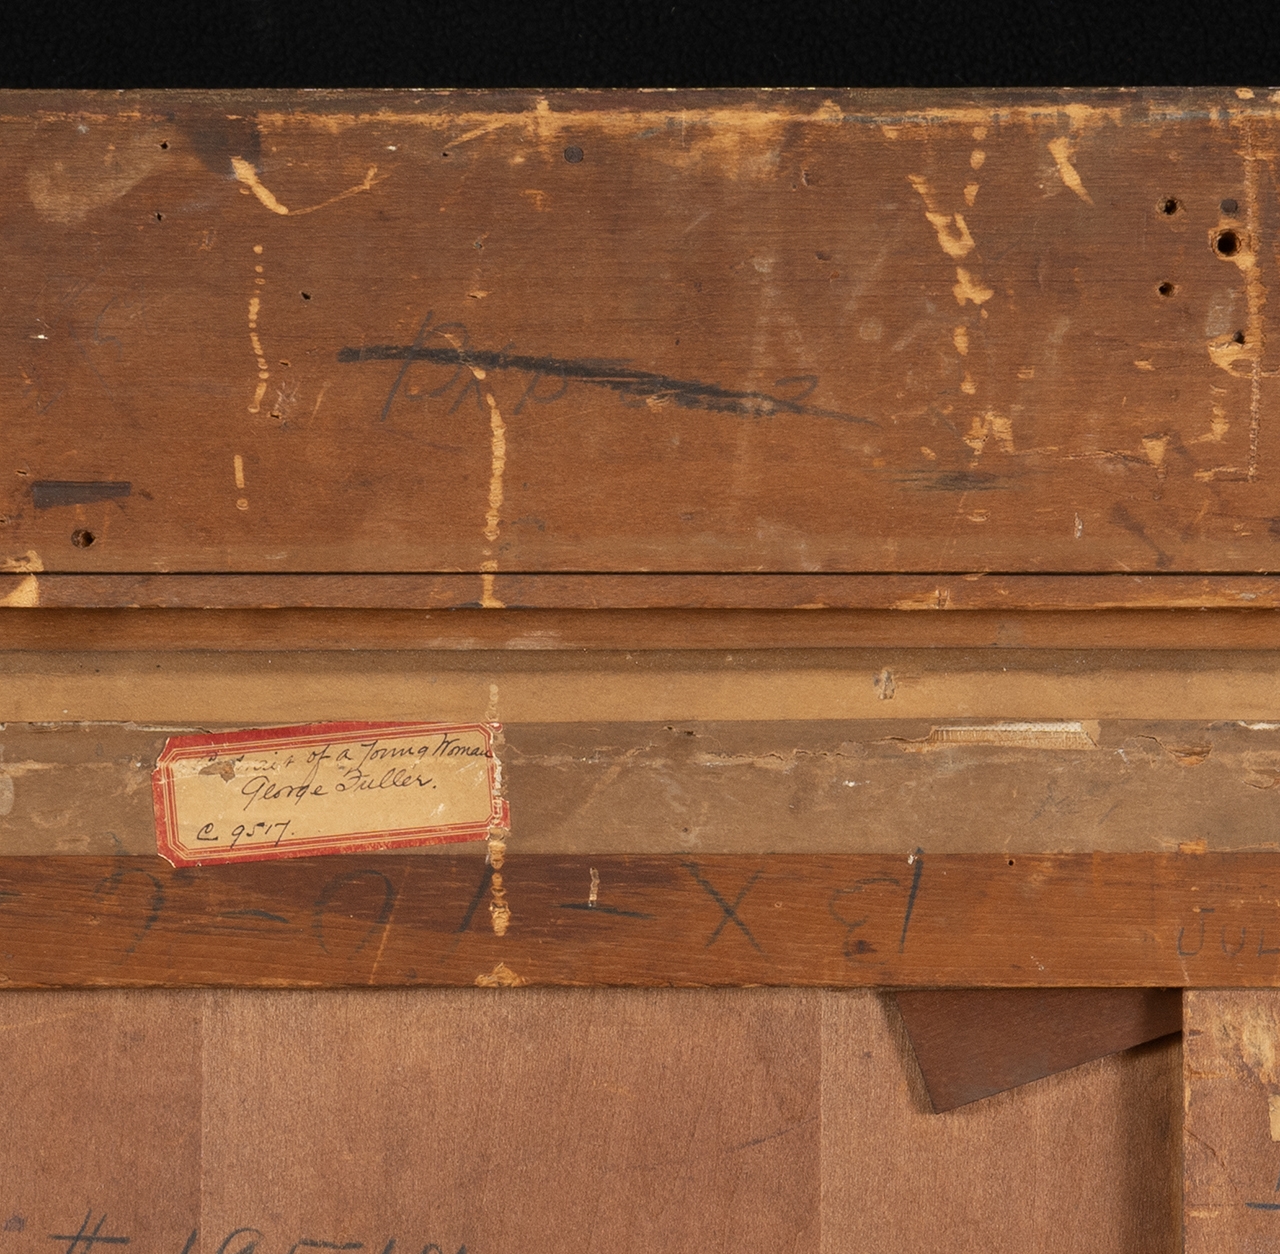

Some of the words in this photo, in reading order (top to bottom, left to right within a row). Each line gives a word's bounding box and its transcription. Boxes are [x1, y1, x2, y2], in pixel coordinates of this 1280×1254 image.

[336, 748, 355, 762] a
[431, 732, 494, 759] Woman
[240, 775, 329, 811] George
